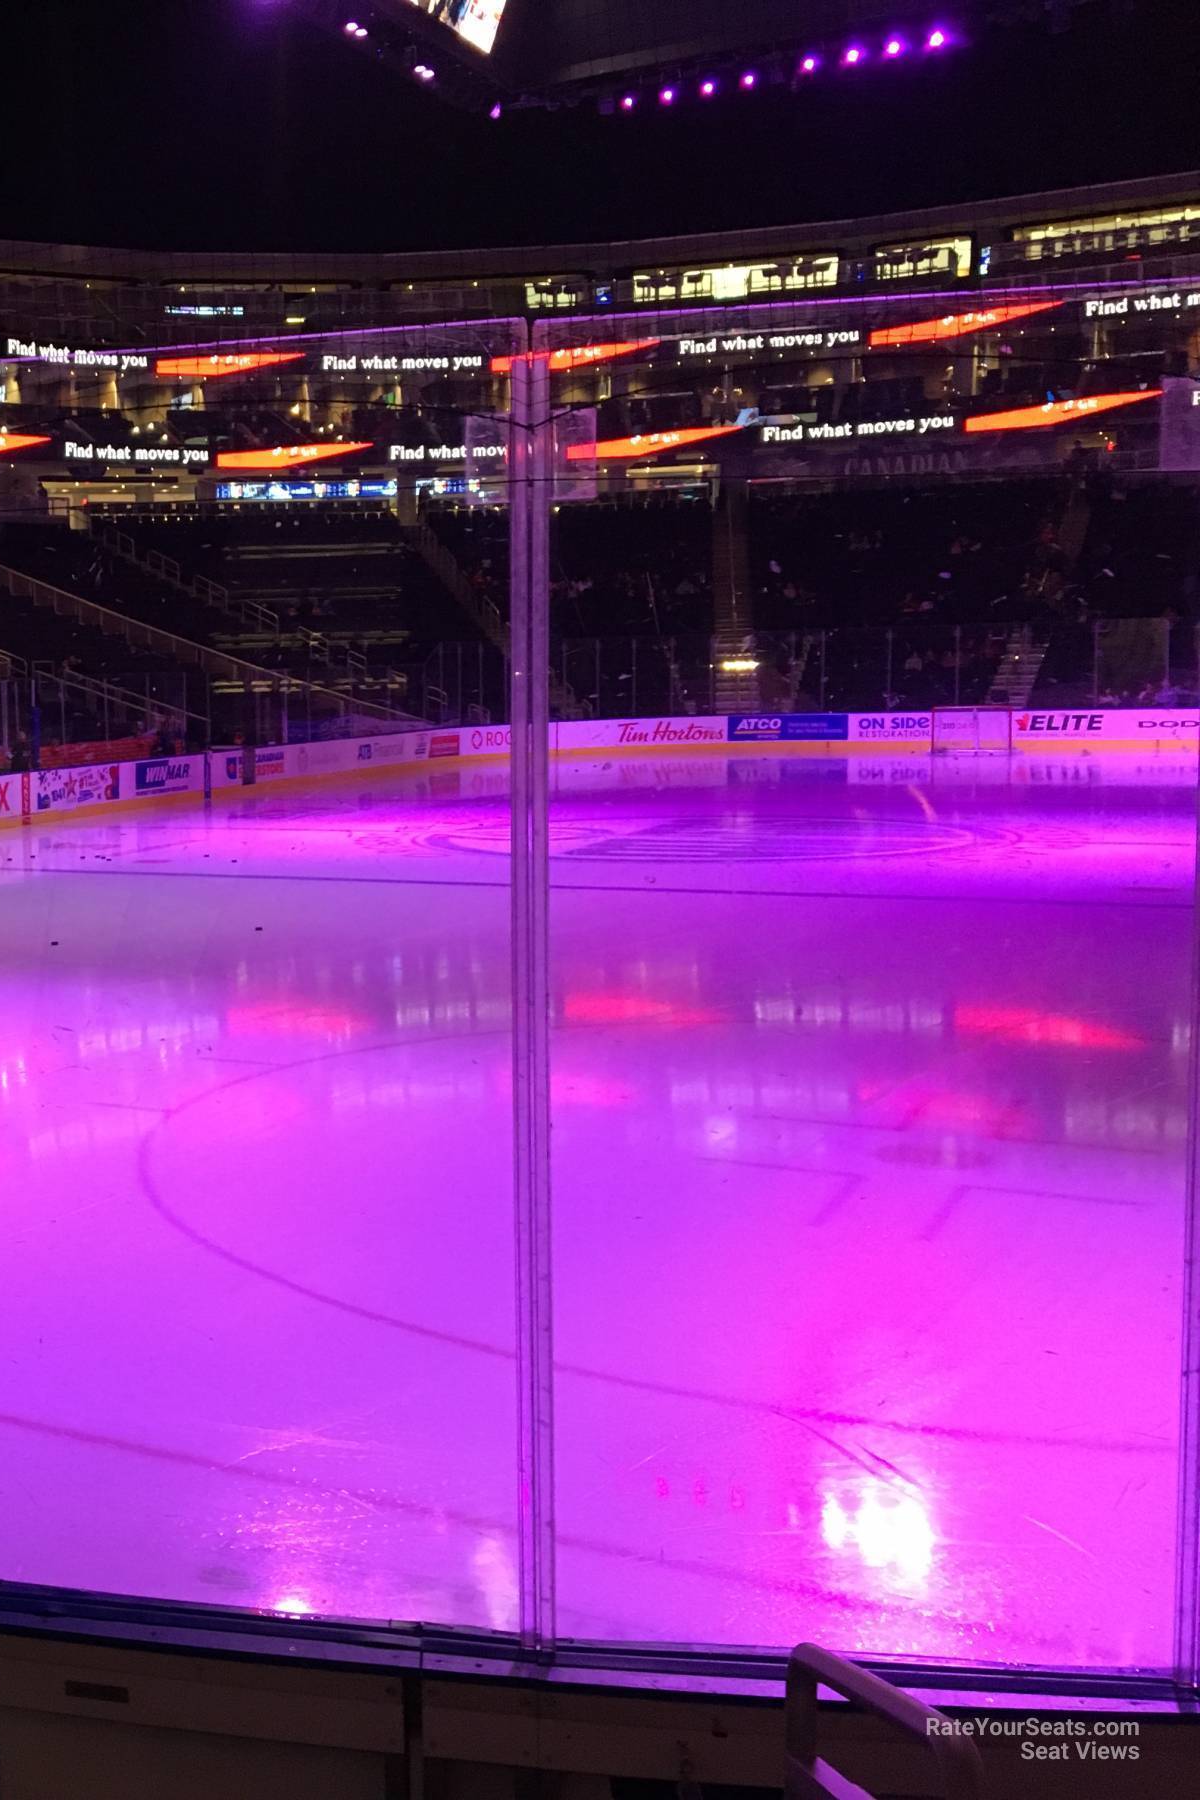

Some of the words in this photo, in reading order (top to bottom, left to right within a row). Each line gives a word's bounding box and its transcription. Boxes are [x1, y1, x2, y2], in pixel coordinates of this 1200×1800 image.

[1086, 298, 1128, 316] Find
[1134, 293, 1181, 311] what
[680, 340, 716, 356] Find
[721, 336, 763, 353] what
[770, 334, 822, 348] moves
[826, 331, 860, 348] you
[7, 338, 36, 357] Find
[39, 344, 70, 363] what
[74, 350, 118, 365] moves
[121, 356, 148, 370] you
[323, 356, 356, 370] Find
[361, 355, 398, 370] what
[402, 357, 449, 369] moves
[453, 356, 482, 370] you
[763, 425, 803, 442] Find
[808, 423, 852, 438] what
[857, 419, 915, 434] moves
[919, 416, 954, 433] you
[65, 442, 93, 458] Find
[96, 444, 131, 459] what
[135, 449, 179, 461] moves
[183, 450, 209, 464] you
[390, 445, 424, 460] Find
[429, 445, 467, 459] what
[472, 446, 508, 457] mov
[618, 723, 648, 742] Tim
[652, 721, 724, 741] Hortons
[736, 719, 781, 730] ATCO
[858, 718, 884, 729] ON
[1029, 715, 1104, 731] ELITE
[859, 730, 931, 738] RESTORATION
[145, 763, 191, 783] WINMAR
